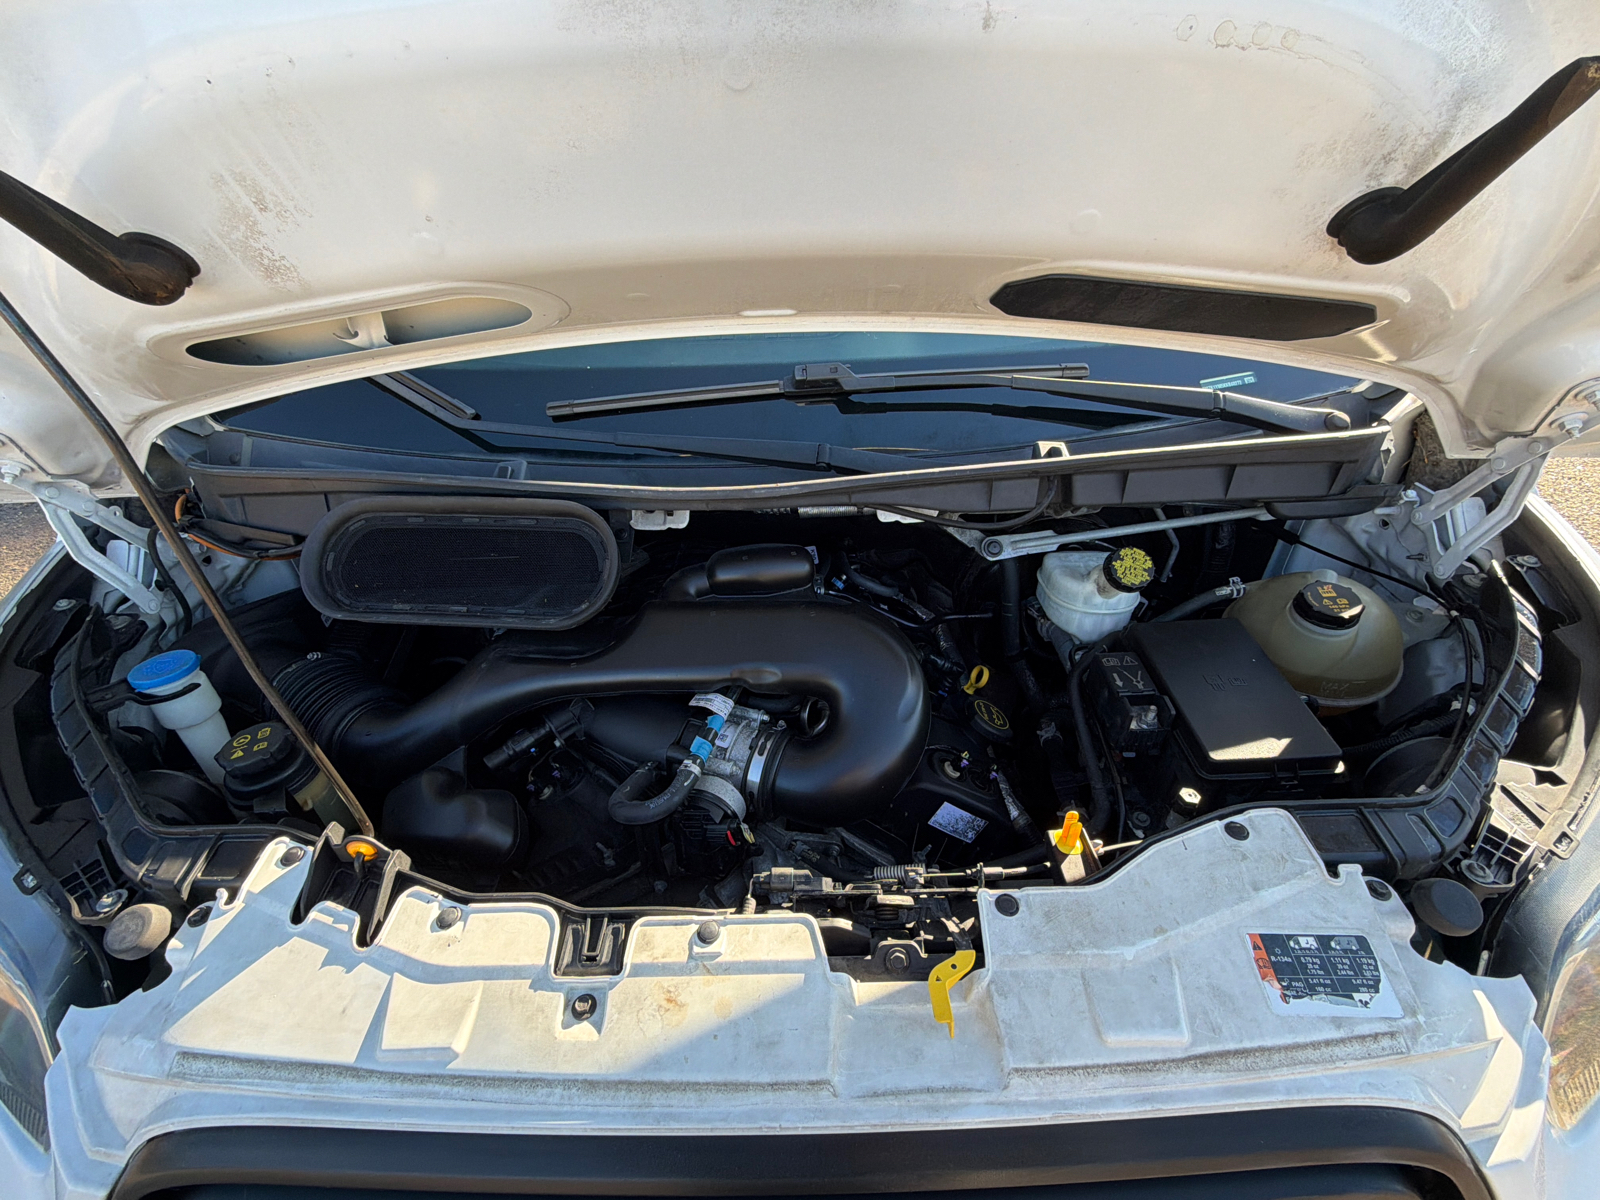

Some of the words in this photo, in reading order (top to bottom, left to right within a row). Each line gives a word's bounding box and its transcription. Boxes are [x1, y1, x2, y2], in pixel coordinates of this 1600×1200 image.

[1270, 955, 1293, 963] R-134a
[1312, 956, 1321, 964] kg
[1341, 957, 1350, 965] kg
[1367, 957, 1376, 965] kg
